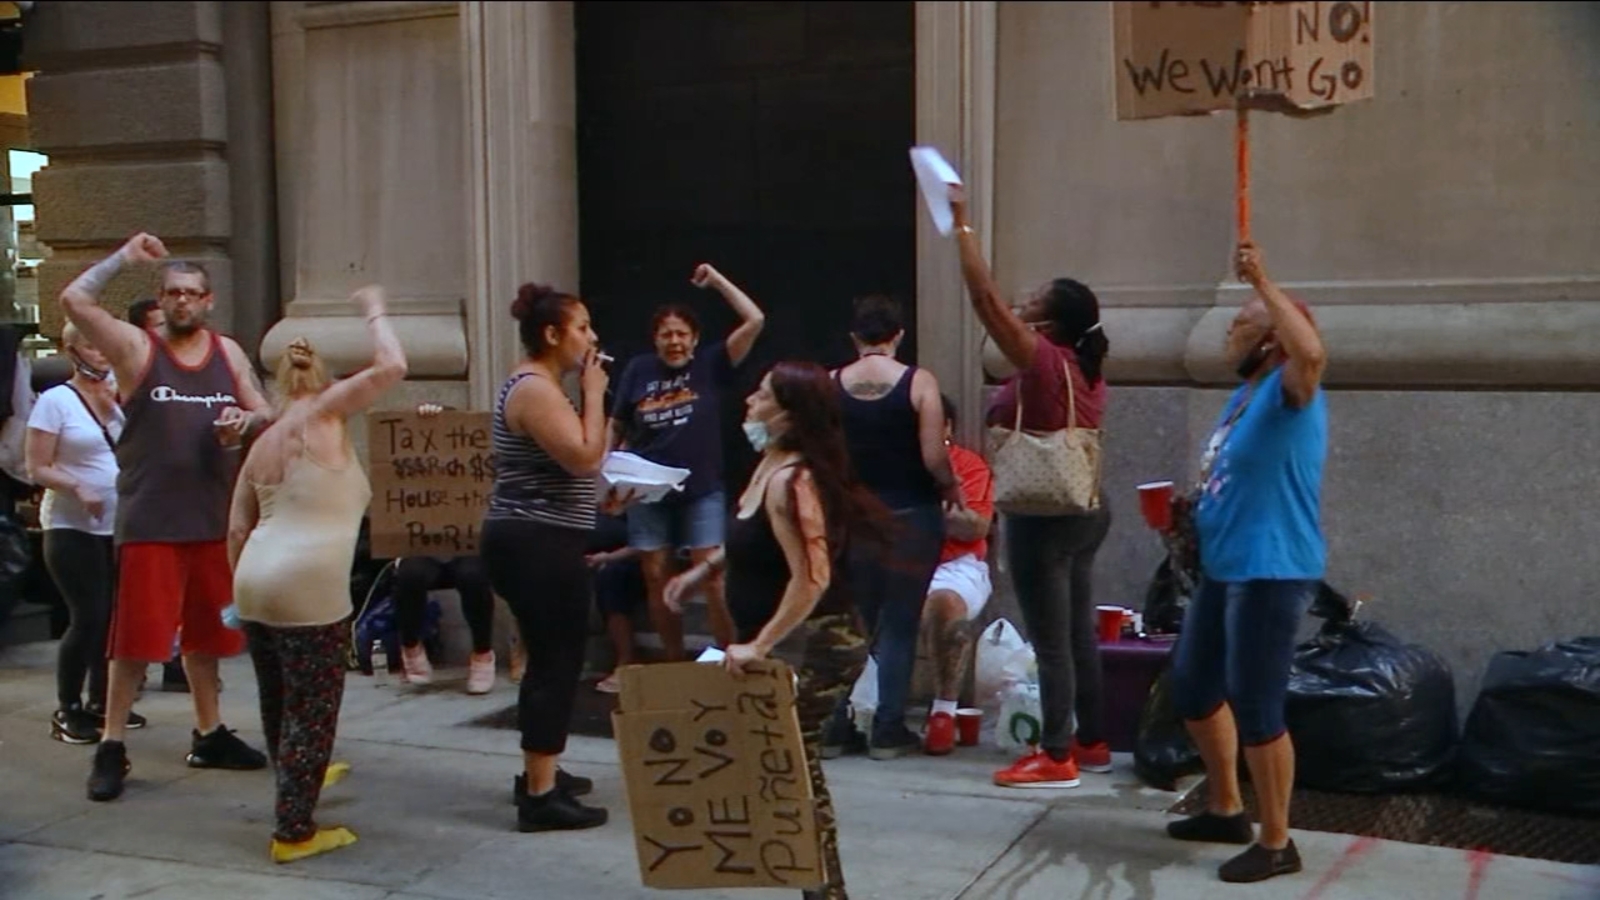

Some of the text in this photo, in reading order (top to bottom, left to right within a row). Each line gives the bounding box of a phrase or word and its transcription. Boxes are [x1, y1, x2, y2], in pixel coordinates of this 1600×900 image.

[1298, 1, 1370, 45] NO!
[1124, 49, 1195, 96] We
[380, 418, 490, 455] Tax the
[455, 489, 494, 510] th
[704, 795, 756, 875] ME
